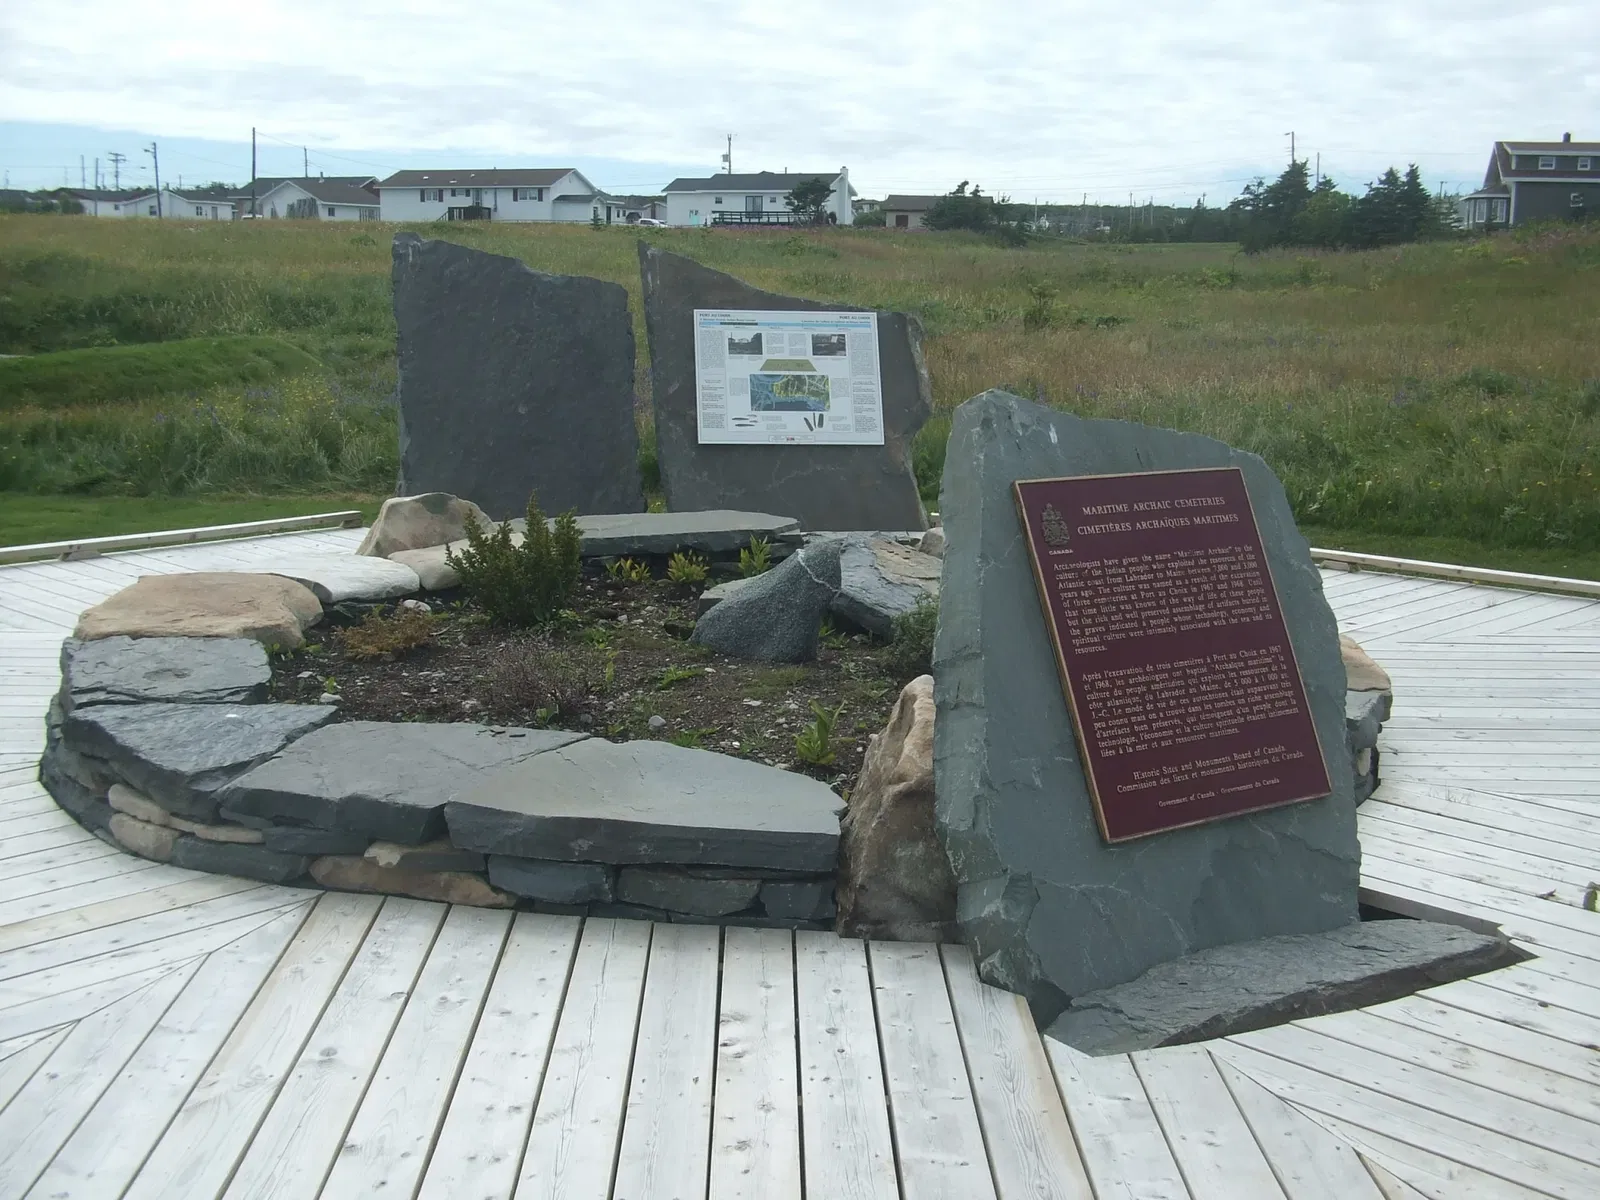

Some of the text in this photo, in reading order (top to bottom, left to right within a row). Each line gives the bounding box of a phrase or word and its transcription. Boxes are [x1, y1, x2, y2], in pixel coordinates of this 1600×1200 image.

[1082, 497, 1225, 515] MARITIME ARCHAIC CEMETERIES
[1077, 514, 1239, 535] CIMETIÈRES ARCHAÏQUES MARITIMES
[1103, 558, 1119, 566] have
[1122, 556, 1139, 565] given
[1141, 554, 1152, 562] the
[1243, 544, 1253, 552] the
[1058, 579, 1085, 589] Atlantic
[1106, 576, 1123, 584] from
[1125, 573, 1154, 582] Labrador
[1104, 566, 1126, 575] Indian
[1128, 563, 1149, 574] people
[1060, 591, 1078, 600] years
[1081, 590, 1095, 598] ago.
[1097, 586, 1110, 594] The
[1113, 584, 1136, 592] culture
[1063, 599, 1070, 608] of
[1073, 598, 1091, 606] three
[1140, 591, 1155, 599] Port
[1200, 583, 1213, 591] 1967
[1217, 582, 1228, 590] and
[1064, 609, 1079, 617] that
[1082, 607, 1097, 615] time
[1134, 601, 1156, 609] known
[1183, 596, 1194, 604] way
[1197, 593, 1204, 601] of
[1207, 592, 1218, 600] life
[1067, 618, 1079, 626] but
[1095, 614, 1108, 623] rich
[1111, 613, 1123, 621] and
[1125, 611, 1139, 619] well
[1140, 607, 1170, 619] preserved
[1207, 601, 1214, 609] of
[1072, 634, 1100, 647] spiritual
[1103, 632, 1126, 641] culture
[1146, 624, 1177, 635] intimately
[1213, 618, 1226, 626] with
[1085, 626, 1106, 636] graves
[1109, 620, 1138, 631] indicated
[1149, 616, 1170, 627] people
[1232, 607, 1256, 616] economy
[1075, 645, 1107, 655] resources.
[1082, 672, 1102, 682] Après
[1146, 664, 1154, 672] de
[1156, 661, 1171, 670] trois
[1212, 654, 1227, 662] Port
[1268, 645, 1281, 653] 1967
[1086, 691, 1110, 700] culture
[1113, 688, 1122, 696] du
[1188, 676, 1198, 686] qui
[1115, 678, 1125, 686] les
[1089, 701, 1103, 710] côte
[1156, 689, 1186, 699] Labrador
[1112, 708, 1122, 716] Le
[1125, 704, 1143, 713] mode
[1156, 700, 1166, 708] vie
[1280, 680, 1292, 688] très
[1093, 721, 1106, 731] peu
[1108, 718, 1128, 726] connu
[1130, 713, 1146, 722] mais
[1165, 706, 1186, 716] trouvé
[1214, 699, 1236, 708] tombes
[1096, 727, 1130, 738] d'artefacts
[1134, 724, 1149, 732] bien
[1186, 716, 1197, 724] qui
[1193, 722, 1213, 731] culture
[1100, 749, 1116, 757] liées
[1135, 743, 1148, 751] mer
[1161, 739, 1173, 747] aux
[1209, 728, 1240, 738] maritimes.
[1162, 766, 1178, 774] Sites
[1181, 761, 1193, 771] and
[1195, 756, 1231, 768] Monuments
[1233, 750, 1252, 760] Board
[1254, 748, 1260, 756] of
[1117, 780, 1157, 793] Commission
[1160, 777, 1171, 785] des
[1172, 774, 1189, 782] lieux
[1271, 755, 1280, 763] du
